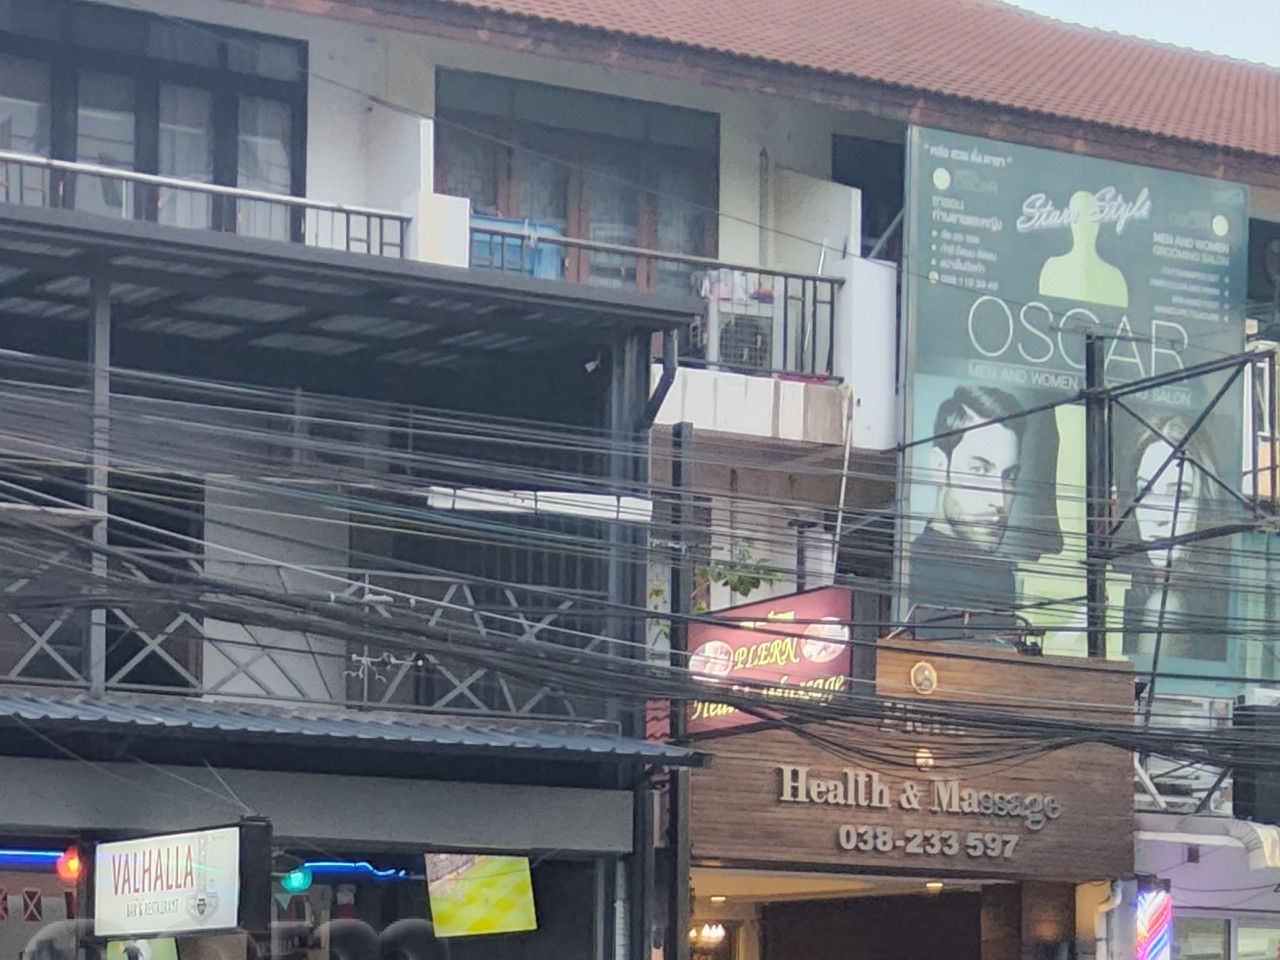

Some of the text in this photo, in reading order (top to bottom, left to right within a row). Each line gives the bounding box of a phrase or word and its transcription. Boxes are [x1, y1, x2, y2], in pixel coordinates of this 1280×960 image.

[1175, 236, 1194, 248] AND
[1195, 239, 1230, 253] WOMEN
[968, 295, 1189, 383] OSCAR
[969, 364, 998, 378] MEN
[1001, 368, 1027, 383] AND
[1031, 373, 1078, 389] WOMEN
[1152, 390, 1191, 406] SALON
[733, 636, 801, 670] PLERN
[777, 765, 1062, 830] Health & Massage
[839, 824, 1019, 858] 038-233 597
[112, 844, 194, 897] VALHALLA
